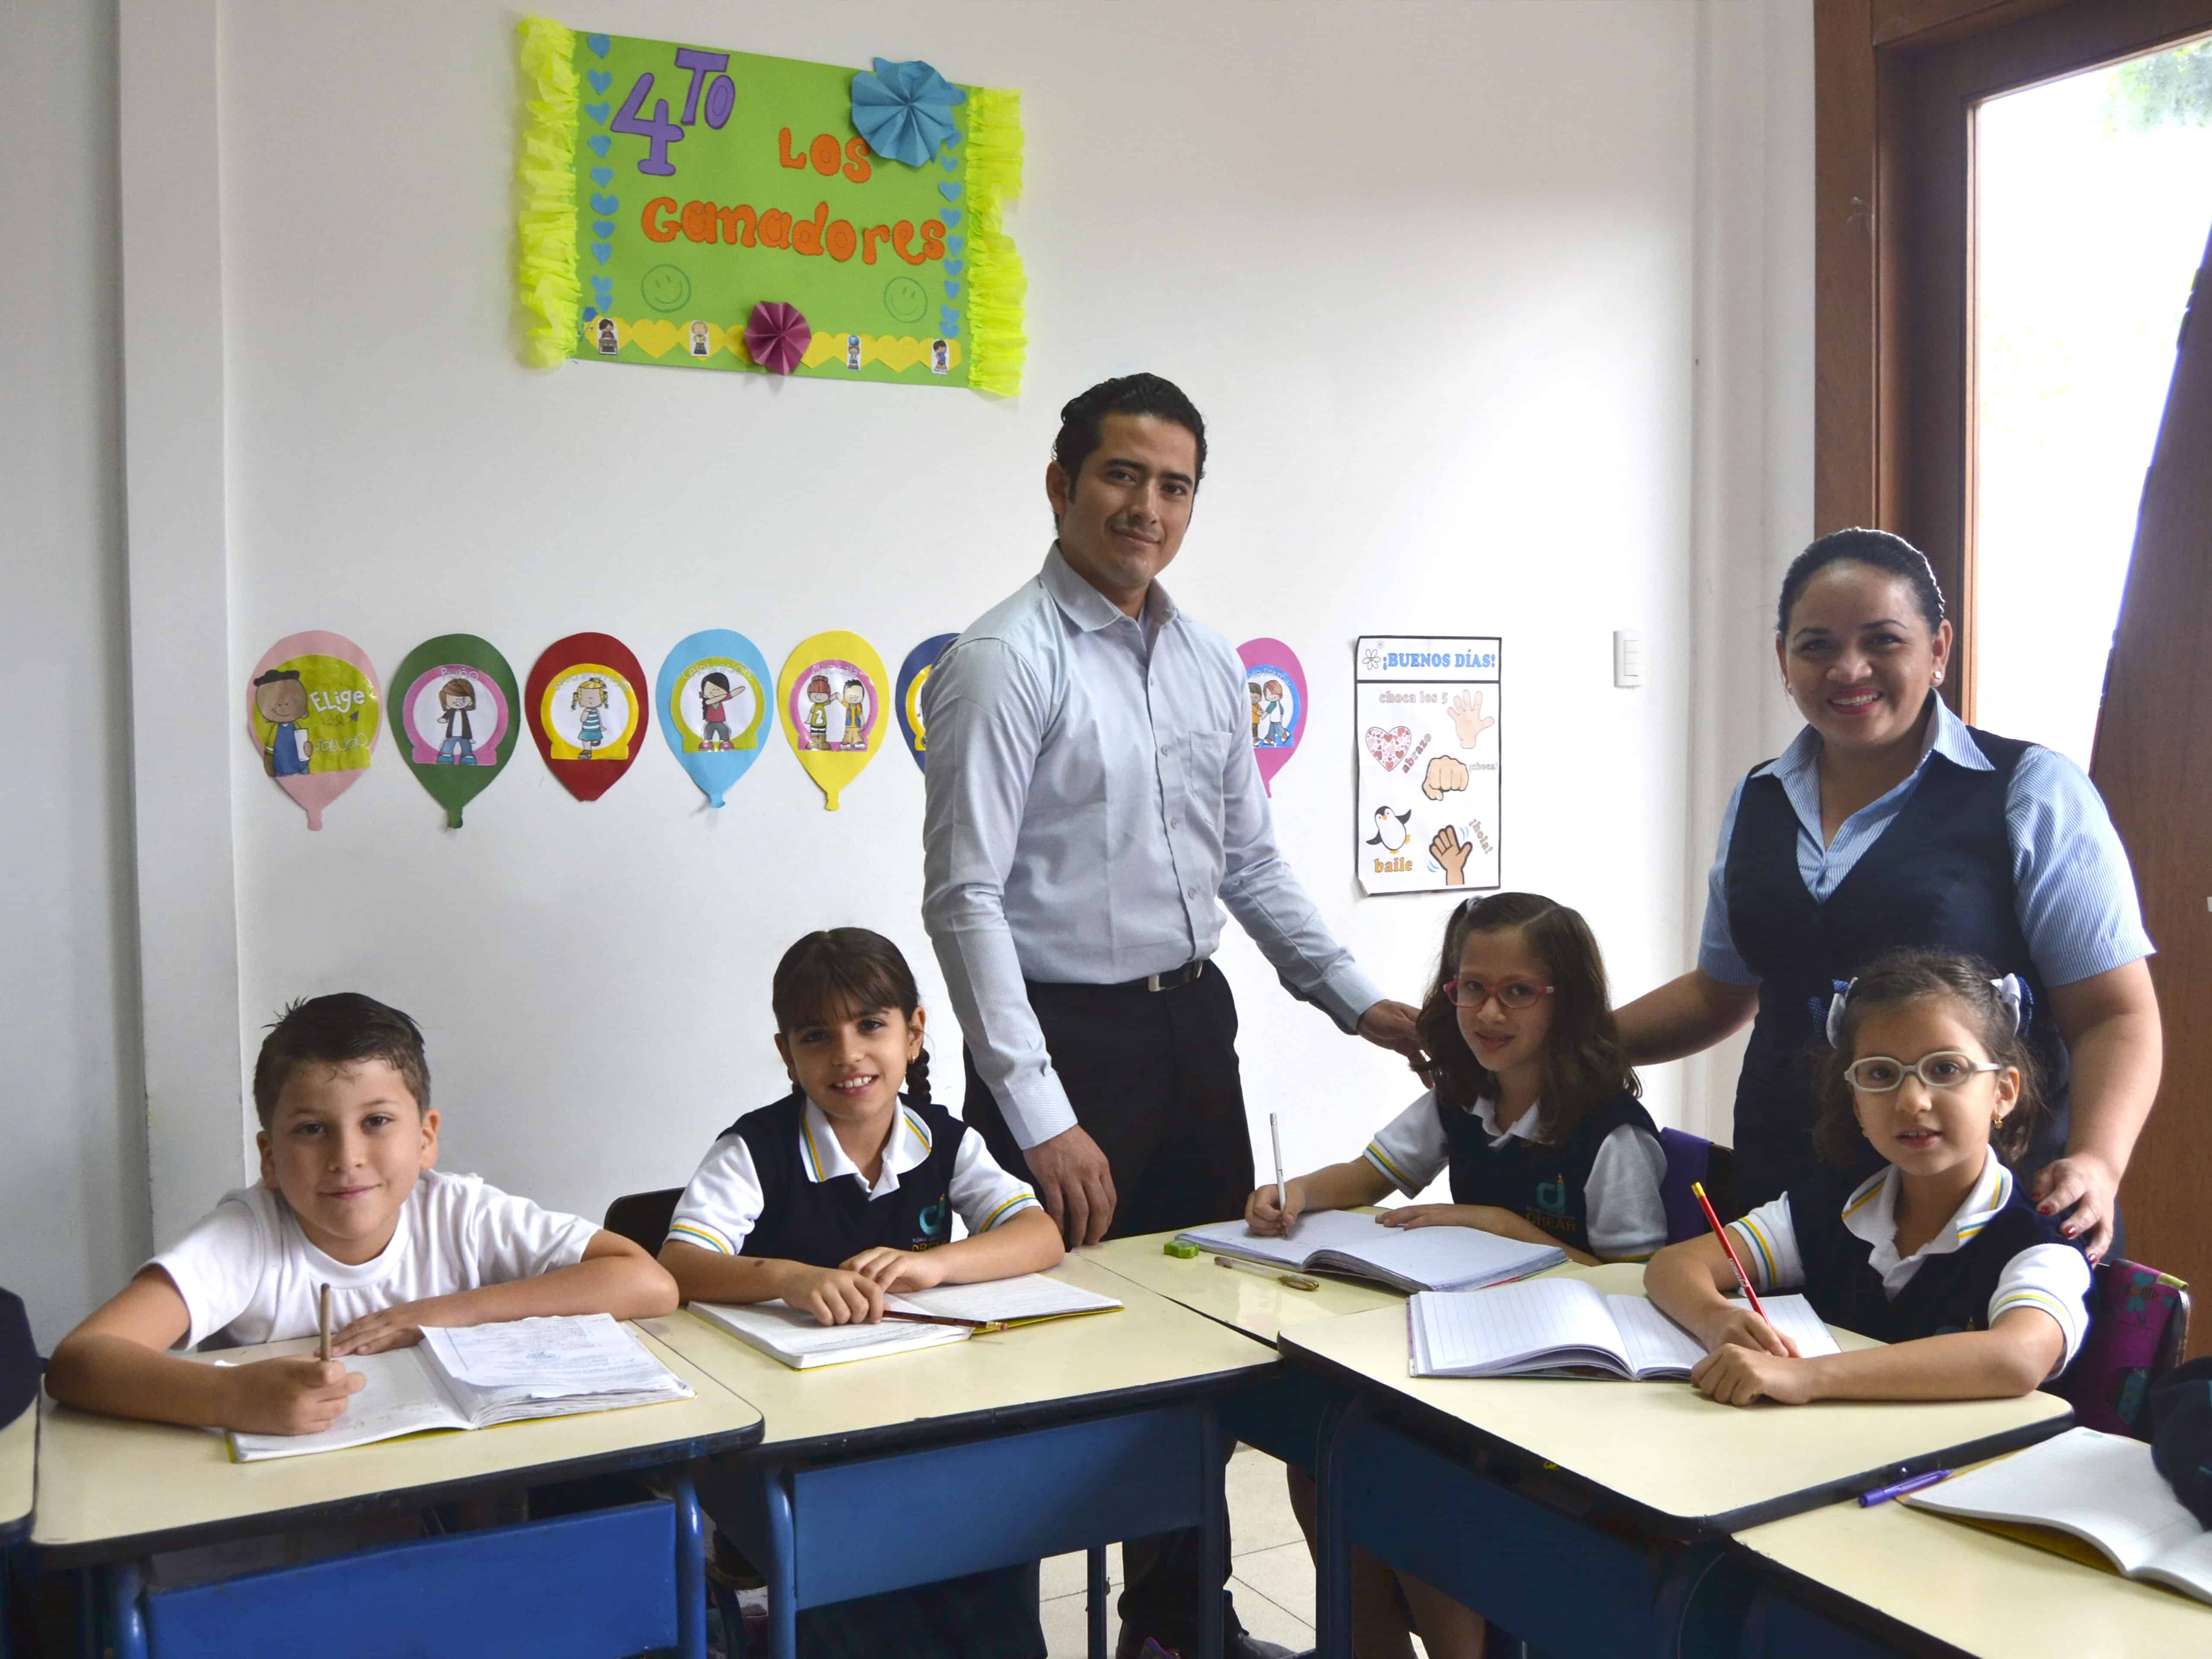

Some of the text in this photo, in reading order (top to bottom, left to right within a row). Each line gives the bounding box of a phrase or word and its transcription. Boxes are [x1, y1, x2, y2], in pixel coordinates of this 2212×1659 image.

[779, 127, 871, 183] LOS
[641, 196, 945, 265] Ganadores
[1382, 649, 1496, 671] ¡BUENOS DÍAS!
[1379, 690, 1448, 705] choca los 5
[815, 710, 824, 725] 2
[1374, 857, 1413, 873] baile
